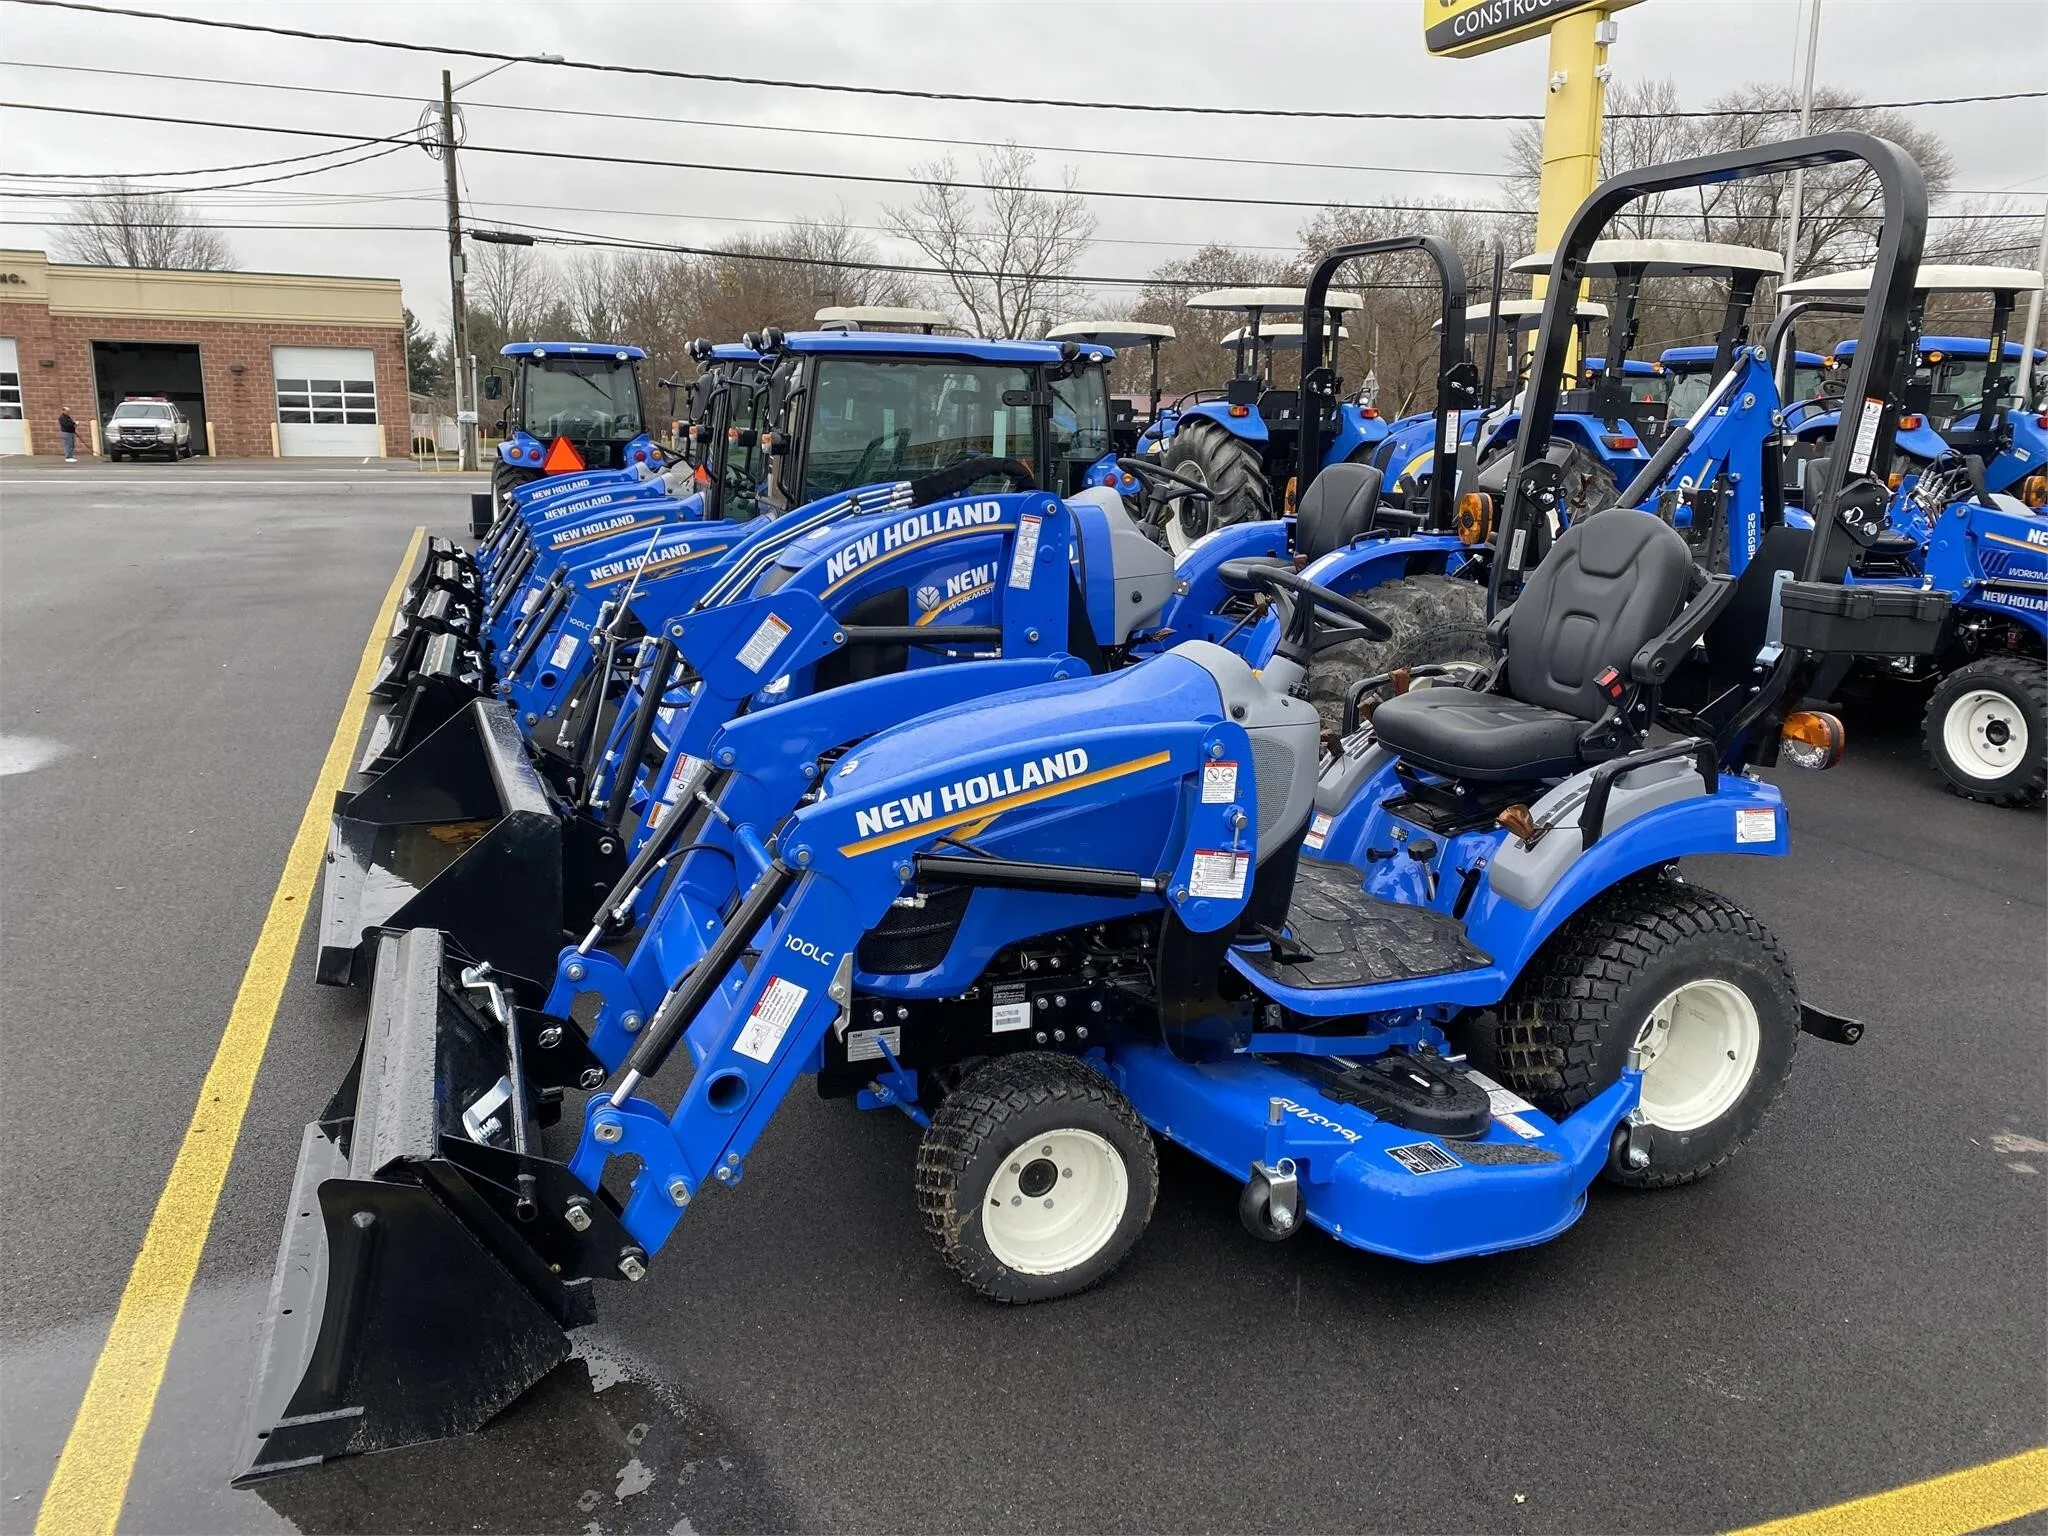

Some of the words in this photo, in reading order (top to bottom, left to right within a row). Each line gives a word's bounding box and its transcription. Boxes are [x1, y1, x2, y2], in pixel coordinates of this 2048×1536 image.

[532, 487, 551, 500] NEW
[552, 479, 590, 495] HOLLAND
[544, 506, 567, 520] NEW
[568, 494, 612, 514] HOLLAND
[553, 530, 581, 544] NEW
[583, 514, 635, 538] HOLLAND
[827, 532, 878, 585] NEW
[884, 501, 1001, 552] HOLLAND
[590, 561, 624, 581] NEW
[626, 542, 691, 571] HOLLAND
[946, 564, 988, 598] NEW
[1982, 590, 2008, 604] NEW
[855, 791, 933, 838] NEW
[940, 748, 1089, 813] HOLLAND
[784, 933, 835, 966] 100LC
